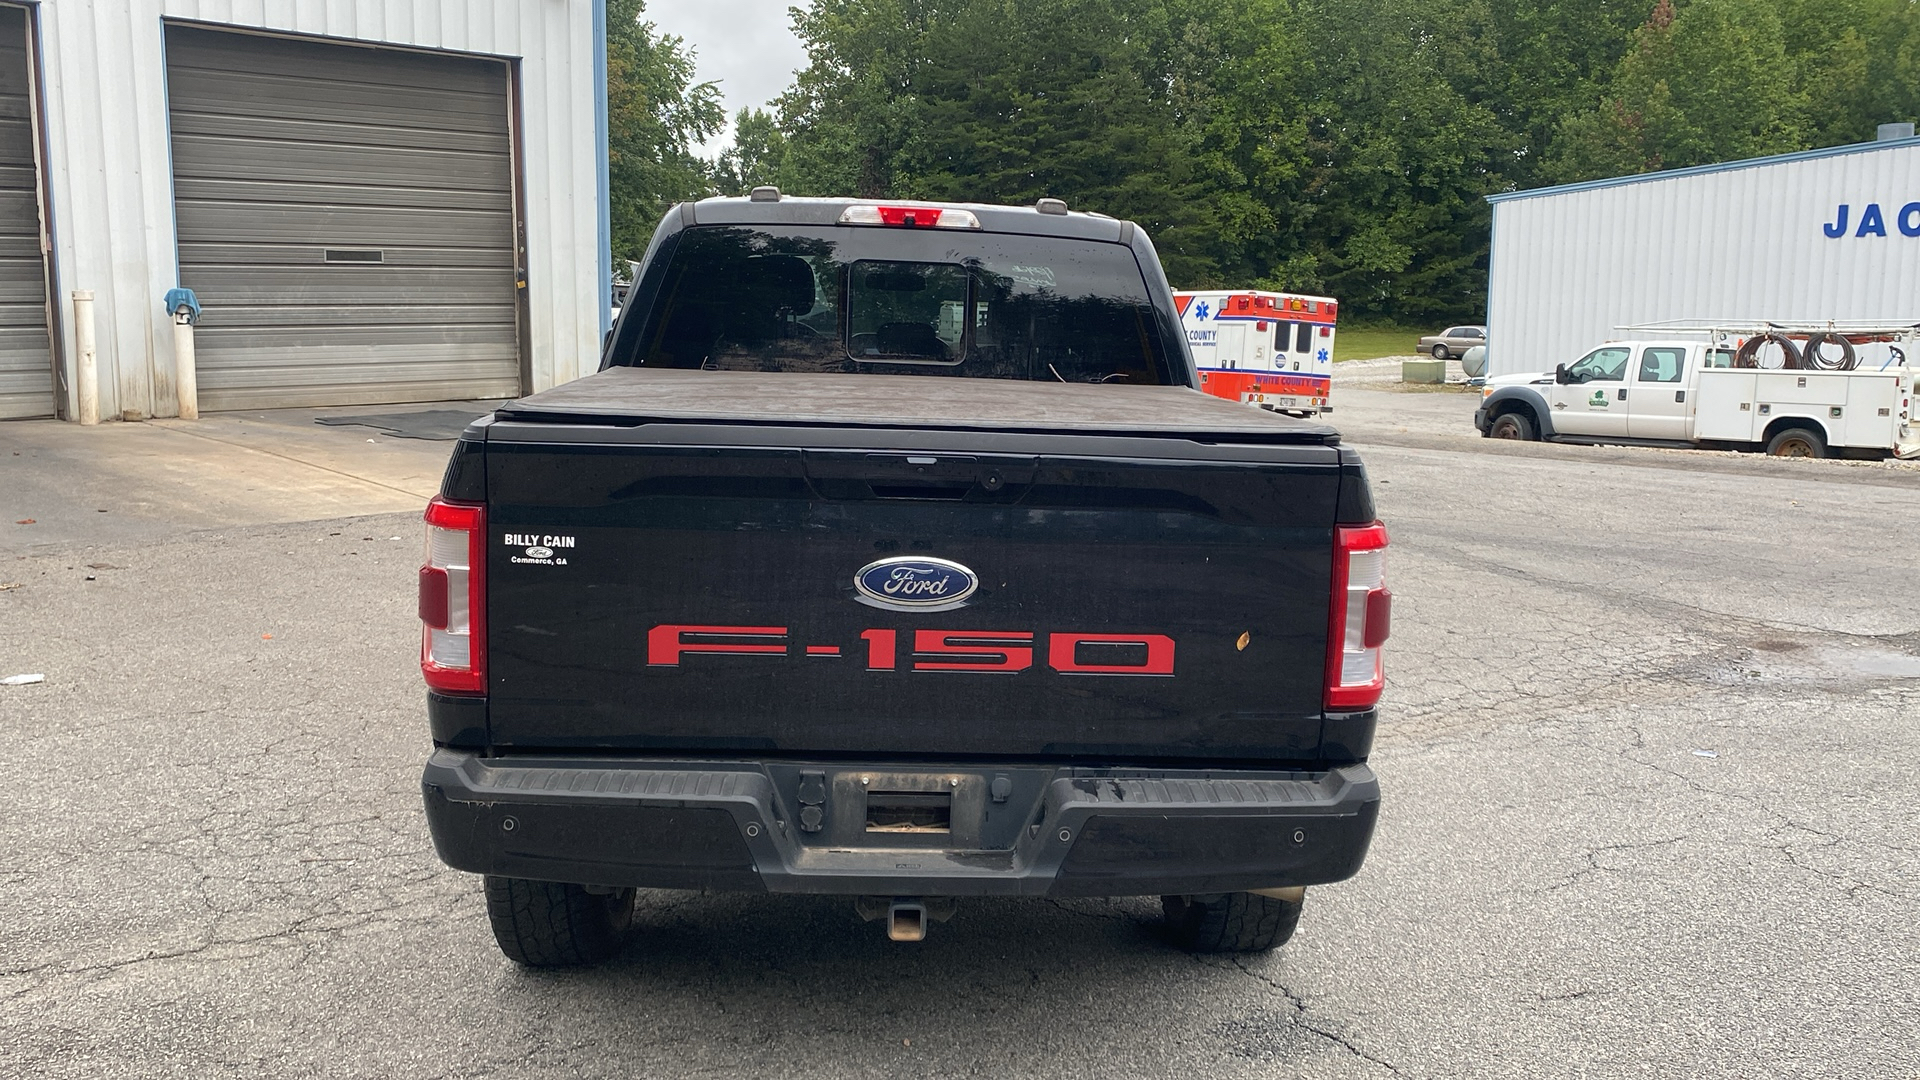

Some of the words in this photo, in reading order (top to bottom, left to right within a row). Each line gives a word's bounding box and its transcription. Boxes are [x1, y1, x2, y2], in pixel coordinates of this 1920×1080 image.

[1823, 202, 1920, 238] JAC
[1189, 330, 1217, 340] COUNTY
[1255, 375, 1279, 385] WHITE
[1281, 376, 1311, 387] COUNTY
[504, 533, 540, 546] BILLY
[543, 535, 575, 548] CAIN
[511, 556, 554, 566] Commerce,
[883, 566, 950, 595] Ford
[647, 624, 1176, 675] F-150
